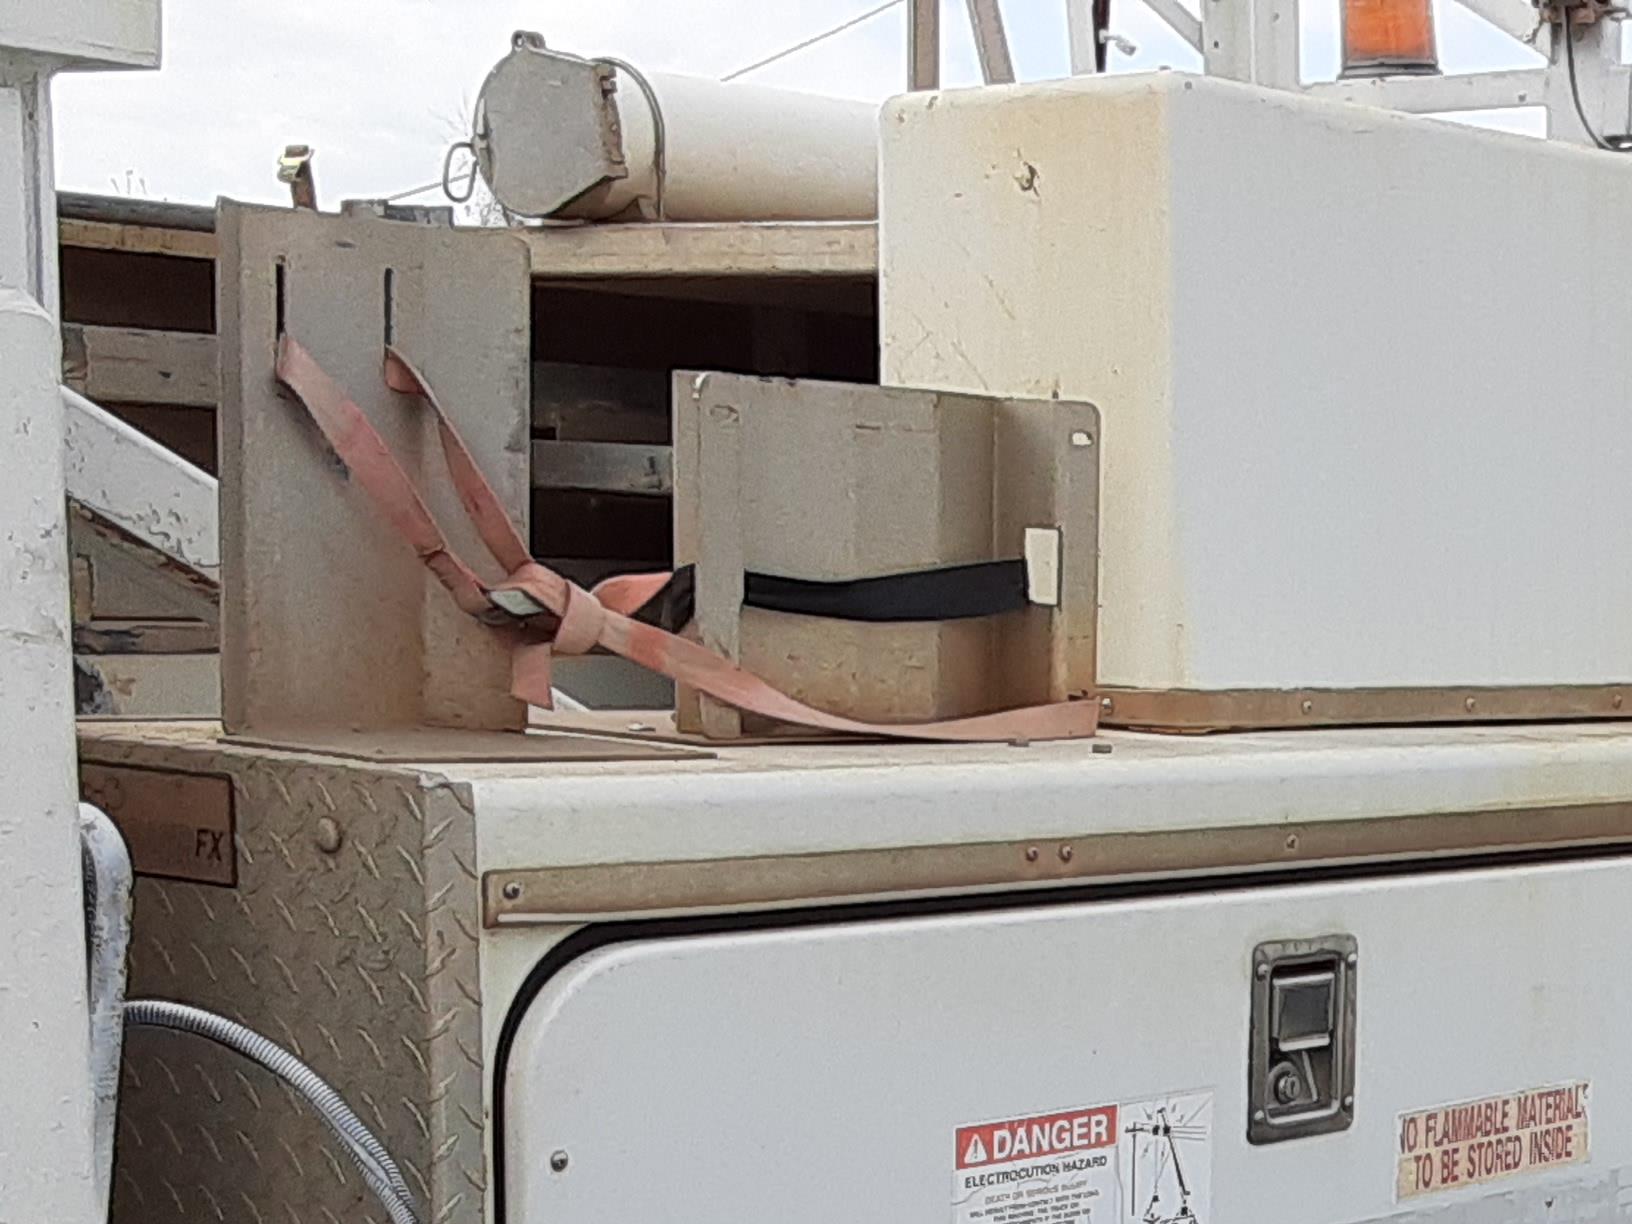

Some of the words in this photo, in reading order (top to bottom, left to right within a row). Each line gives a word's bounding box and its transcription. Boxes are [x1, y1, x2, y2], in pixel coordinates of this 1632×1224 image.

[992, 1113, 1108, 1161] DANGER
[1425, 1099, 1510, 1149] FLAMMABLE
[964, 1160, 1060, 1189] ELECTROCUTION
[1062, 1155, 1108, 1173] HAZARD
[1413, 1153, 1433, 1190] TO
[1440, 1147, 1460, 1184] BE
[1466, 1134, 1523, 1179] STORED
[1528, 1124, 1573, 1165] INSIDE
